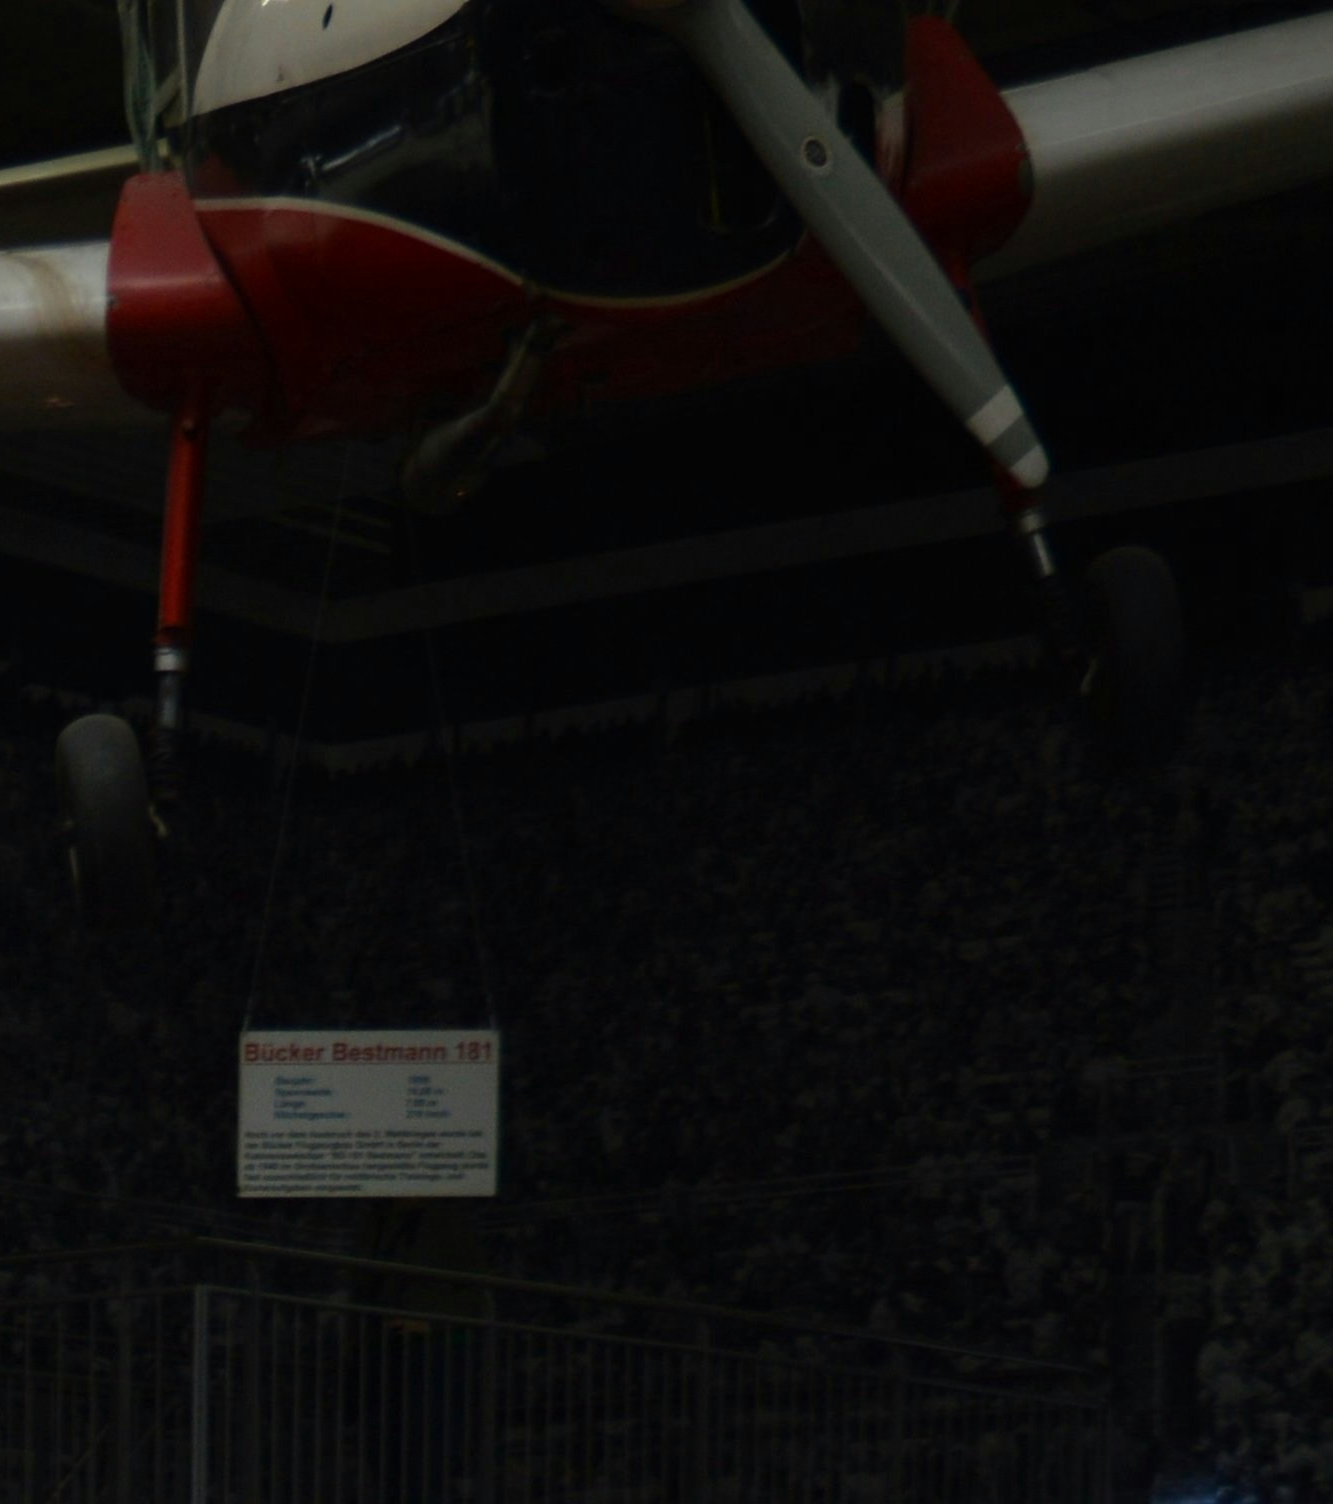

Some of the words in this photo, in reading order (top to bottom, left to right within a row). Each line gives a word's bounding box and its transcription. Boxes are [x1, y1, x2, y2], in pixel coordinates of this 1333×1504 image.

[244, 1041, 324, 1062] Bücker
[332, 1041, 446, 1062] Bestmann
[455, 1040, 493, 1062] 181
